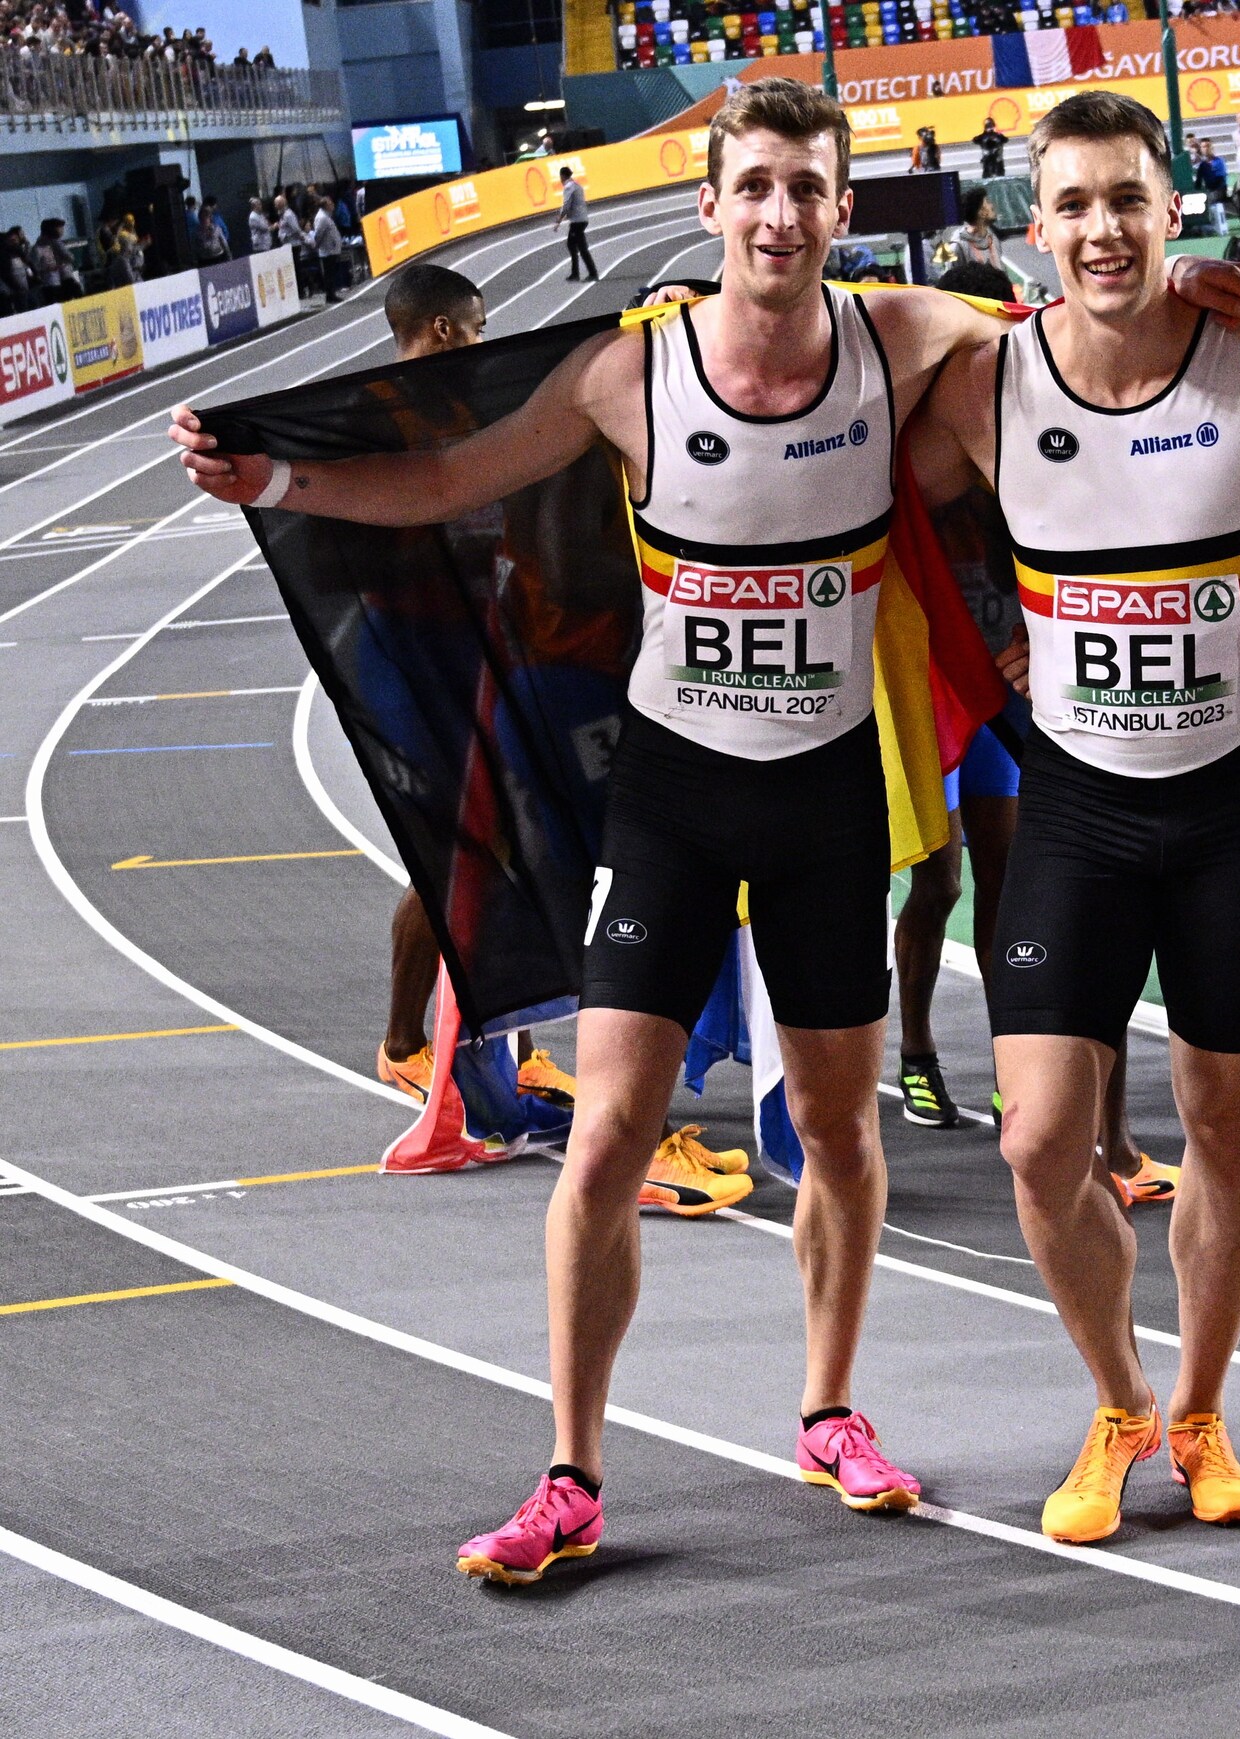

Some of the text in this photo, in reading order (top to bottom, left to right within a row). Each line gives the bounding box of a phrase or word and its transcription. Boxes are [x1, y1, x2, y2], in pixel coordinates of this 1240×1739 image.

[140, 304, 171, 343] TOYO
[0, 336, 52, 393] SPAR
[692, 449, 723, 459] vermarc
[784, 433, 846, 461] Allianz
[1130, 433, 1193, 456] Allianz
[674, 572, 801, 603] SPAR
[1060, 586, 1187, 619] SPAR
[685, 615, 834, 675] BEL
[1074, 631, 1222, 691] BEL
[702, 670, 707, 684] I
[711, 671, 747, 687] RUN
[677, 687, 783, 714] ISTANBUL
[1091, 690, 1097, 702] I
[1100, 690, 1132, 704] RUN
[1072, 704, 1225, 731] ISTANBUL 2023
[611, 932, 640, 940] vermarc
